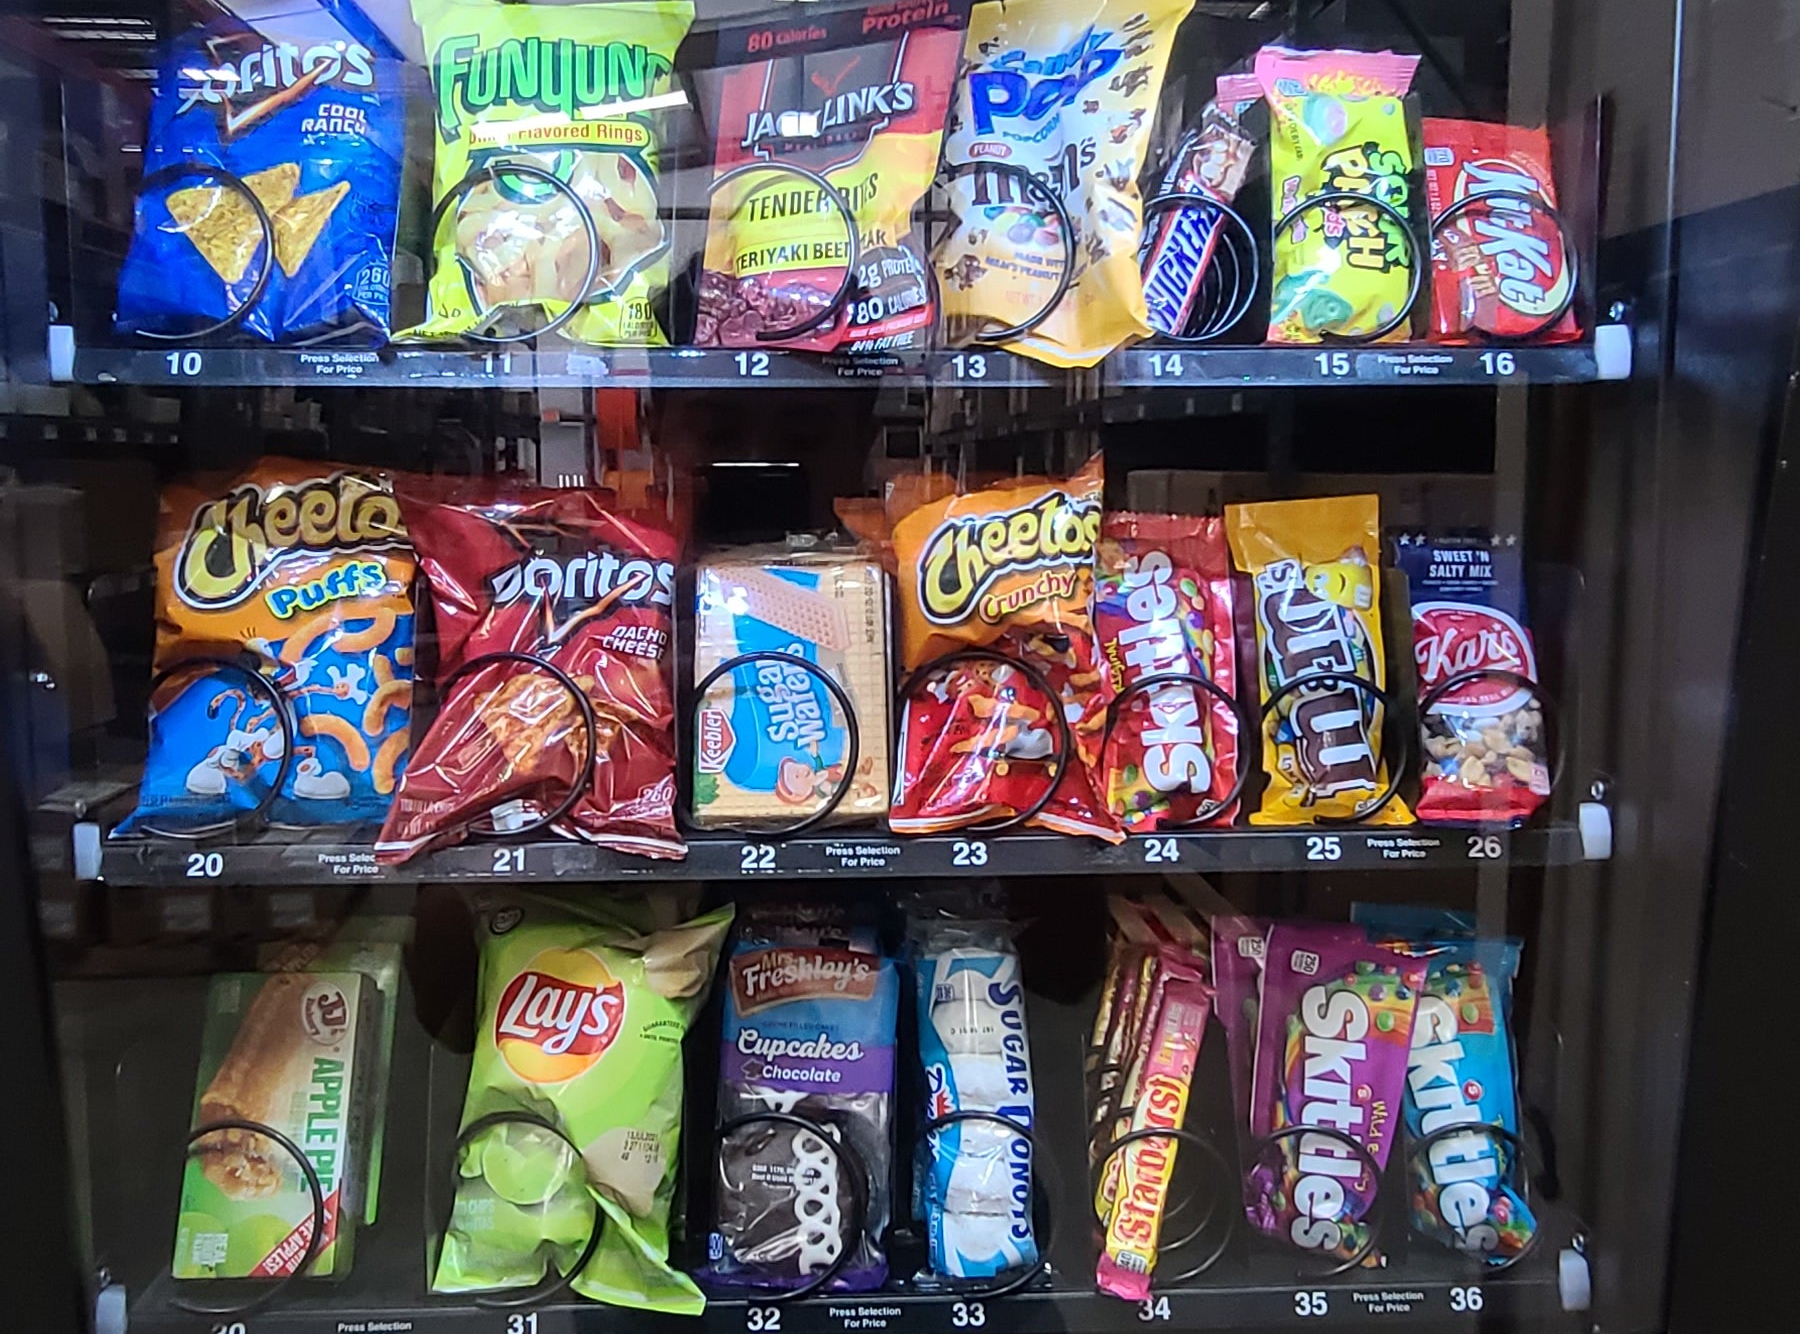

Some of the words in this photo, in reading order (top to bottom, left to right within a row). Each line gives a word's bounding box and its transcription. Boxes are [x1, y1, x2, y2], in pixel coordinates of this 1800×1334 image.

[748, 31, 773, 53] 80
[777, 24, 827, 45] calories
[177, 41, 374, 114] oritos
[318, 104, 367, 123] COOL
[822, 81, 914, 128] LINK'S
[597, 125, 643, 142] Rings
[750, 188, 832, 221] TENDER
[736, 244, 808, 273] TERIYAKI
[360, 267, 390, 288] 260
[628, 302, 652, 320] 180
[857, 297, 884, 325] 80
[166, 352, 202, 375] 10
[301, 354, 329, 363] Press
[331, 353, 379, 363] Selection
[316, 365, 333, 374] For
[336, 365, 362, 374] Price
[734, 352, 769, 376] 12
[952, 355, 986, 378] 13
[1149, 354, 1184, 377] 14
[1315, 353, 1350, 375] 15
[1394, 366, 1410, 374] For
[1413, 366, 1439, 374] Price
[1408, 354, 1453, 363] Selection
[1480, 352, 1515, 375] 16
[838, 368, 854, 377] For
[857, 368, 883, 377] Price
[184, 475, 404, 599] Cheeto
[925, 496, 1101, 614] Cheetos
[1433, 550, 1473, 563] SWEET
[491, 551, 675, 606] Doritos
[1429, 564, 1464, 578] SALTY
[1468, 564, 1492, 578] MIX
[270, 562, 384, 616] Puffs
[981, 570, 1076, 621] Crunchy
[612, 625, 668, 644] NACHO
[602, 635, 665, 659] CHEESE
[1415, 623, 1518, 683] Kar's
[1123, 551, 1211, 795] Skittles
[701, 710, 723, 772] Keebler
[642, 786, 673, 802] 260
[826, 846, 853, 855] Press
[855, 846, 900, 856] Selection
[953, 842, 988, 866] 23
[1144, 839, 1180, 862] 24
[1306, 836, 1341, 860] 25
[1367, 838, 1394, 847] Press
[1396, 837, 1440, 847] Selection
[1383, 849, 1399, 858] For
[1401, 849, 1426, 858] Price
[1467, 836, 1502, 858] 26
[187, 853, 224, 877] 20
[318, 854, 347, 863] Press
[349, 853, 376, 863] Selec
[493, 848, 526, 872] 21
[741, 845, 776, 869] 22
[841, 858, 857, 867] For
[859, 858, 885, 866] Price
[333, 865, 350, 874] For
[352, 865, 379, 874] Price
[1304, 954, 1316, 973] 250
[500, 975, 619, 1055] Lay's
[738, 1027, 864, 1062] Cupcakes
[988, 982, 1029, 1095] SUGAR
[762, 1064, 841, 1083] Chocolate
[304, 1057, 345, 1144] APPLE
[1291, 985, 1370, 1251] Skittles
[1368, 1100, 1388, 1138] Wild
[1407, 994, 1497, 1257] Skittles
[1118, 1077, 1185, 1241] Starburst
[1138, 1296, 1171, 1321] 34
[1294, 1291, 1328, 1316] 35
[1353, 1293, 1379, 1302] Press
[1381, 1292, 1424, 1301] Selection
[1369, 1304, 1384, 1313] For
[1386, 1303, 1410, 1312] Price
[1450, 1286, 1484, 1311] 36
[747, 1307, 781, 1331] 32
[829, 1308, 856, 1317] Press
[858, 1307, 901, 1317] Selection
[844, 1319, 860, 1328] For
[862, 1319, 887, 1328] Price
[952, 1302, 986, 1327] 33
[338, 1323, 366, 1333] Press
[368, 1322, 412, 1332] Selection
